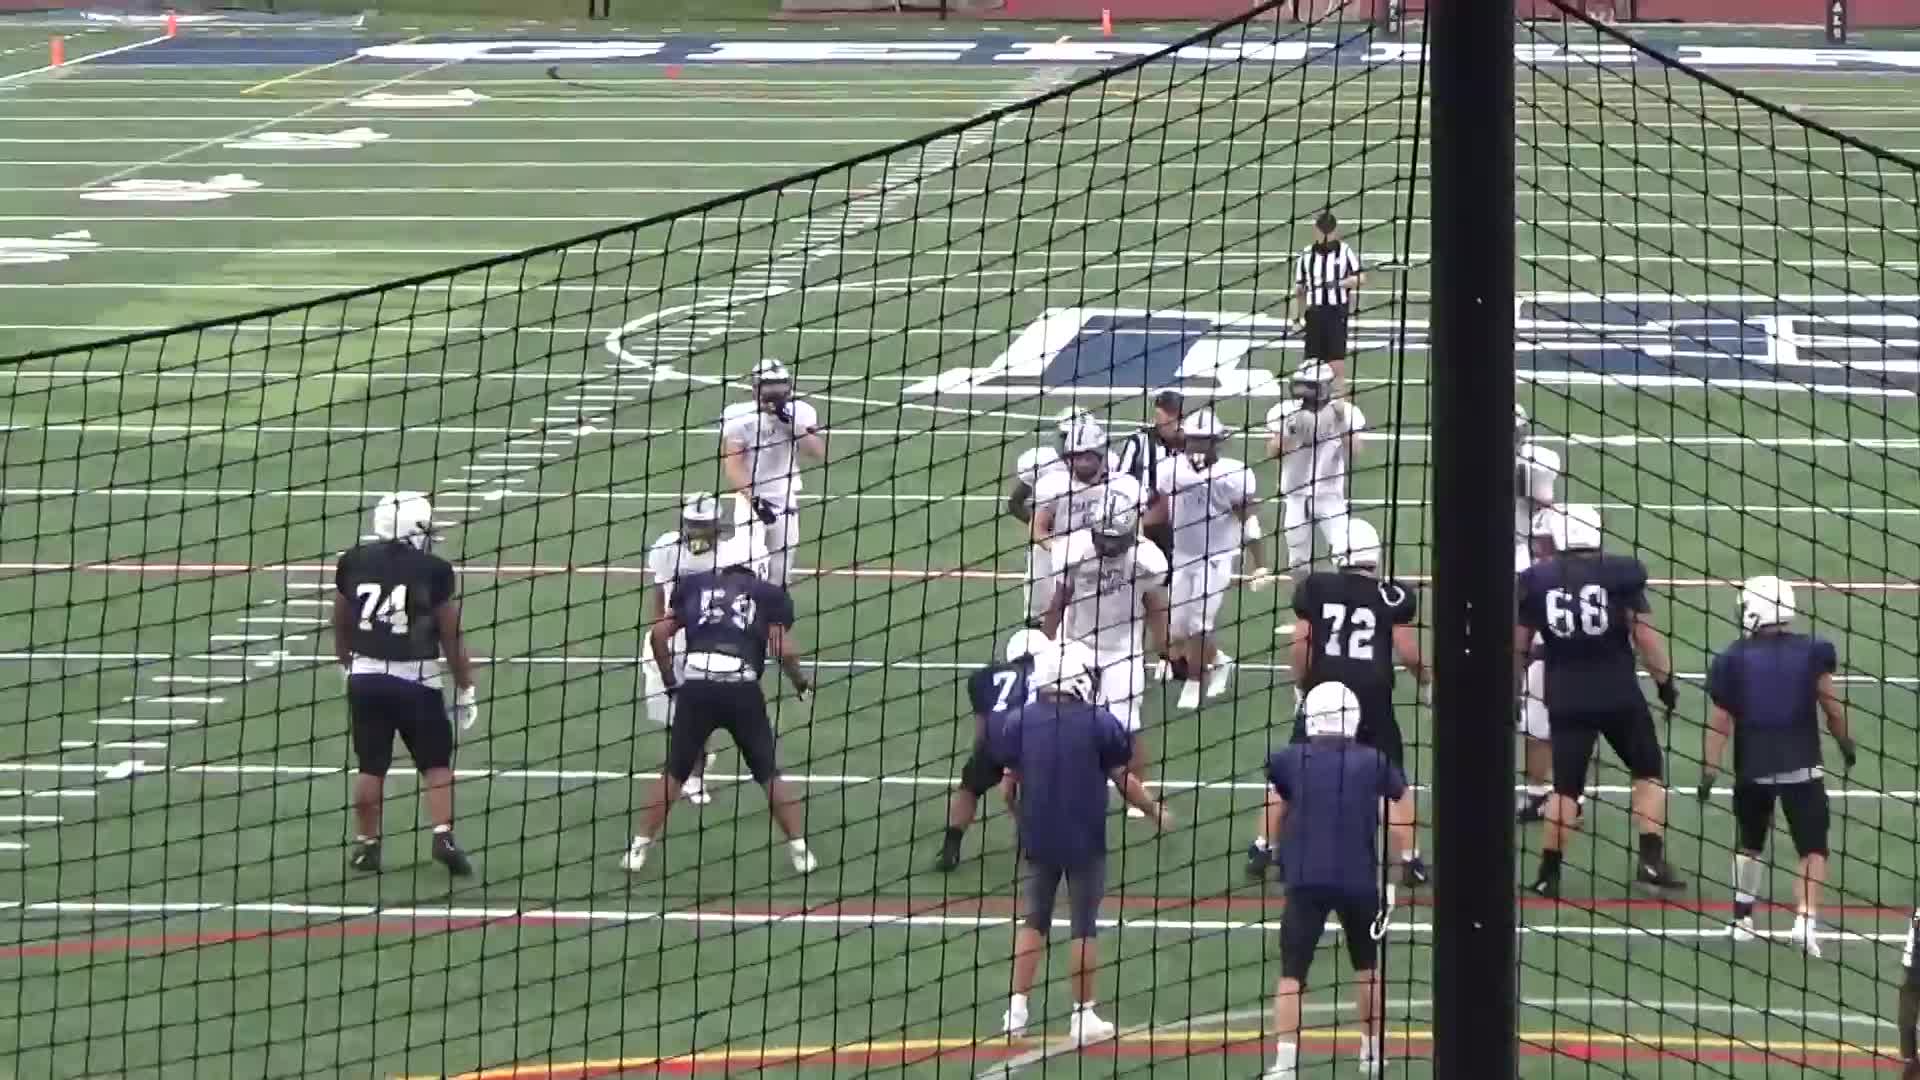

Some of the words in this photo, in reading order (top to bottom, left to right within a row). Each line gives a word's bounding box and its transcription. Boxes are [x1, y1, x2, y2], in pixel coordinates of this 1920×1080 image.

[356, 583, 409, 634] 74
[1322, 602, 1376, 660] 72
[1545, 584, 1609, 637] 68
